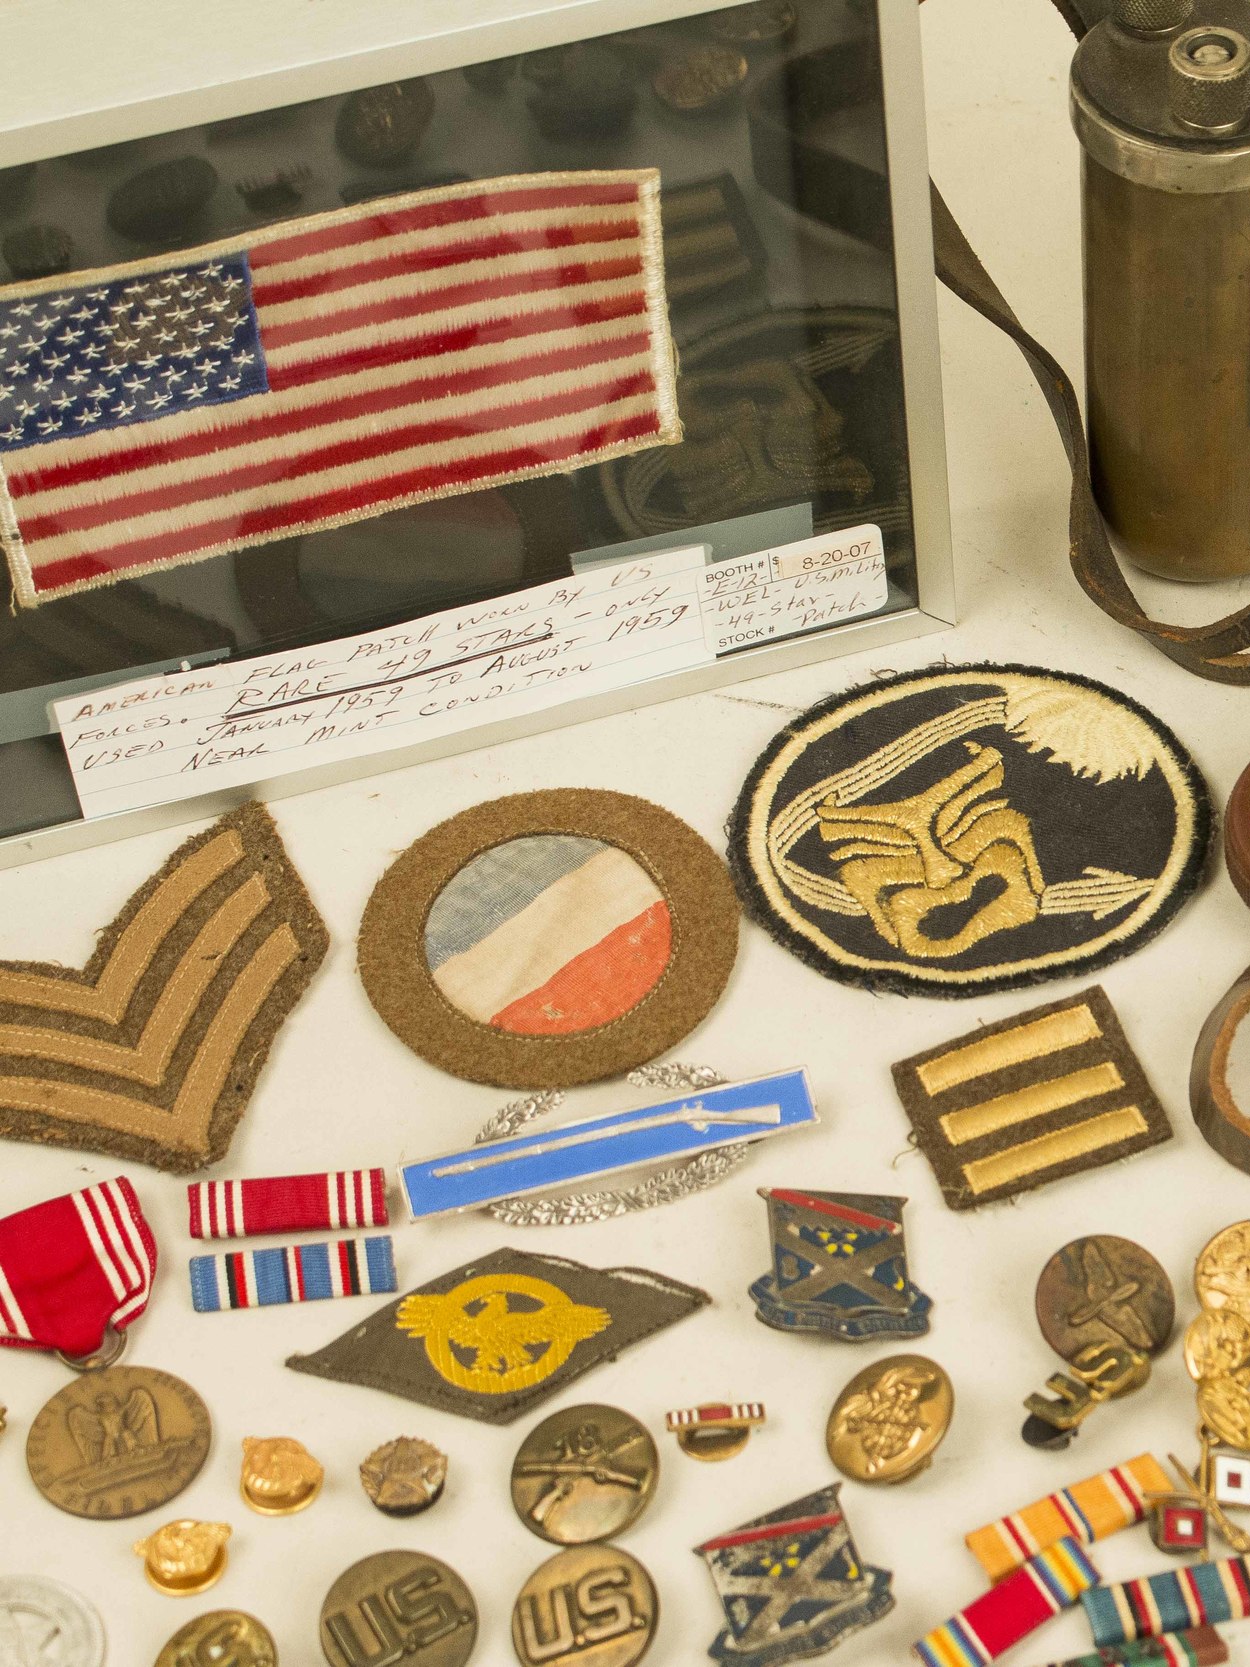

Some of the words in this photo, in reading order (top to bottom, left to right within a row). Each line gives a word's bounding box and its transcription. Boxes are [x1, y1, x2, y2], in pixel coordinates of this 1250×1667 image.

[705, 562, 754, 584] BOOTH
[802, 541, 872, 570] 8-20-07
[72, 680, 216, 722] AMERICAN
[243, 658, 328, 684] FLAG
[347, 622, 441, 662] PATCH
[548, 585, 586, 607] BY
[611, 564, 652, 588] US
[225, 671, 349, 714] RARE
[378, 649, 431, 681] 49
[451, 617, 554, 658] STARS
[718, 627, 765, 648] STOCK
[83, 740, 164, 771] USED
[197, 711, 315, 746] JANUARY
[325, 685, 404, 719] 1959
[426, 670, 463, 694] TO
[480, 635, 588, 678] AUGUST
[607, 604, 689, 643] 1959
[304, 710, 401, 746] MINT
[418, 661, 593, 717] CONDITION
